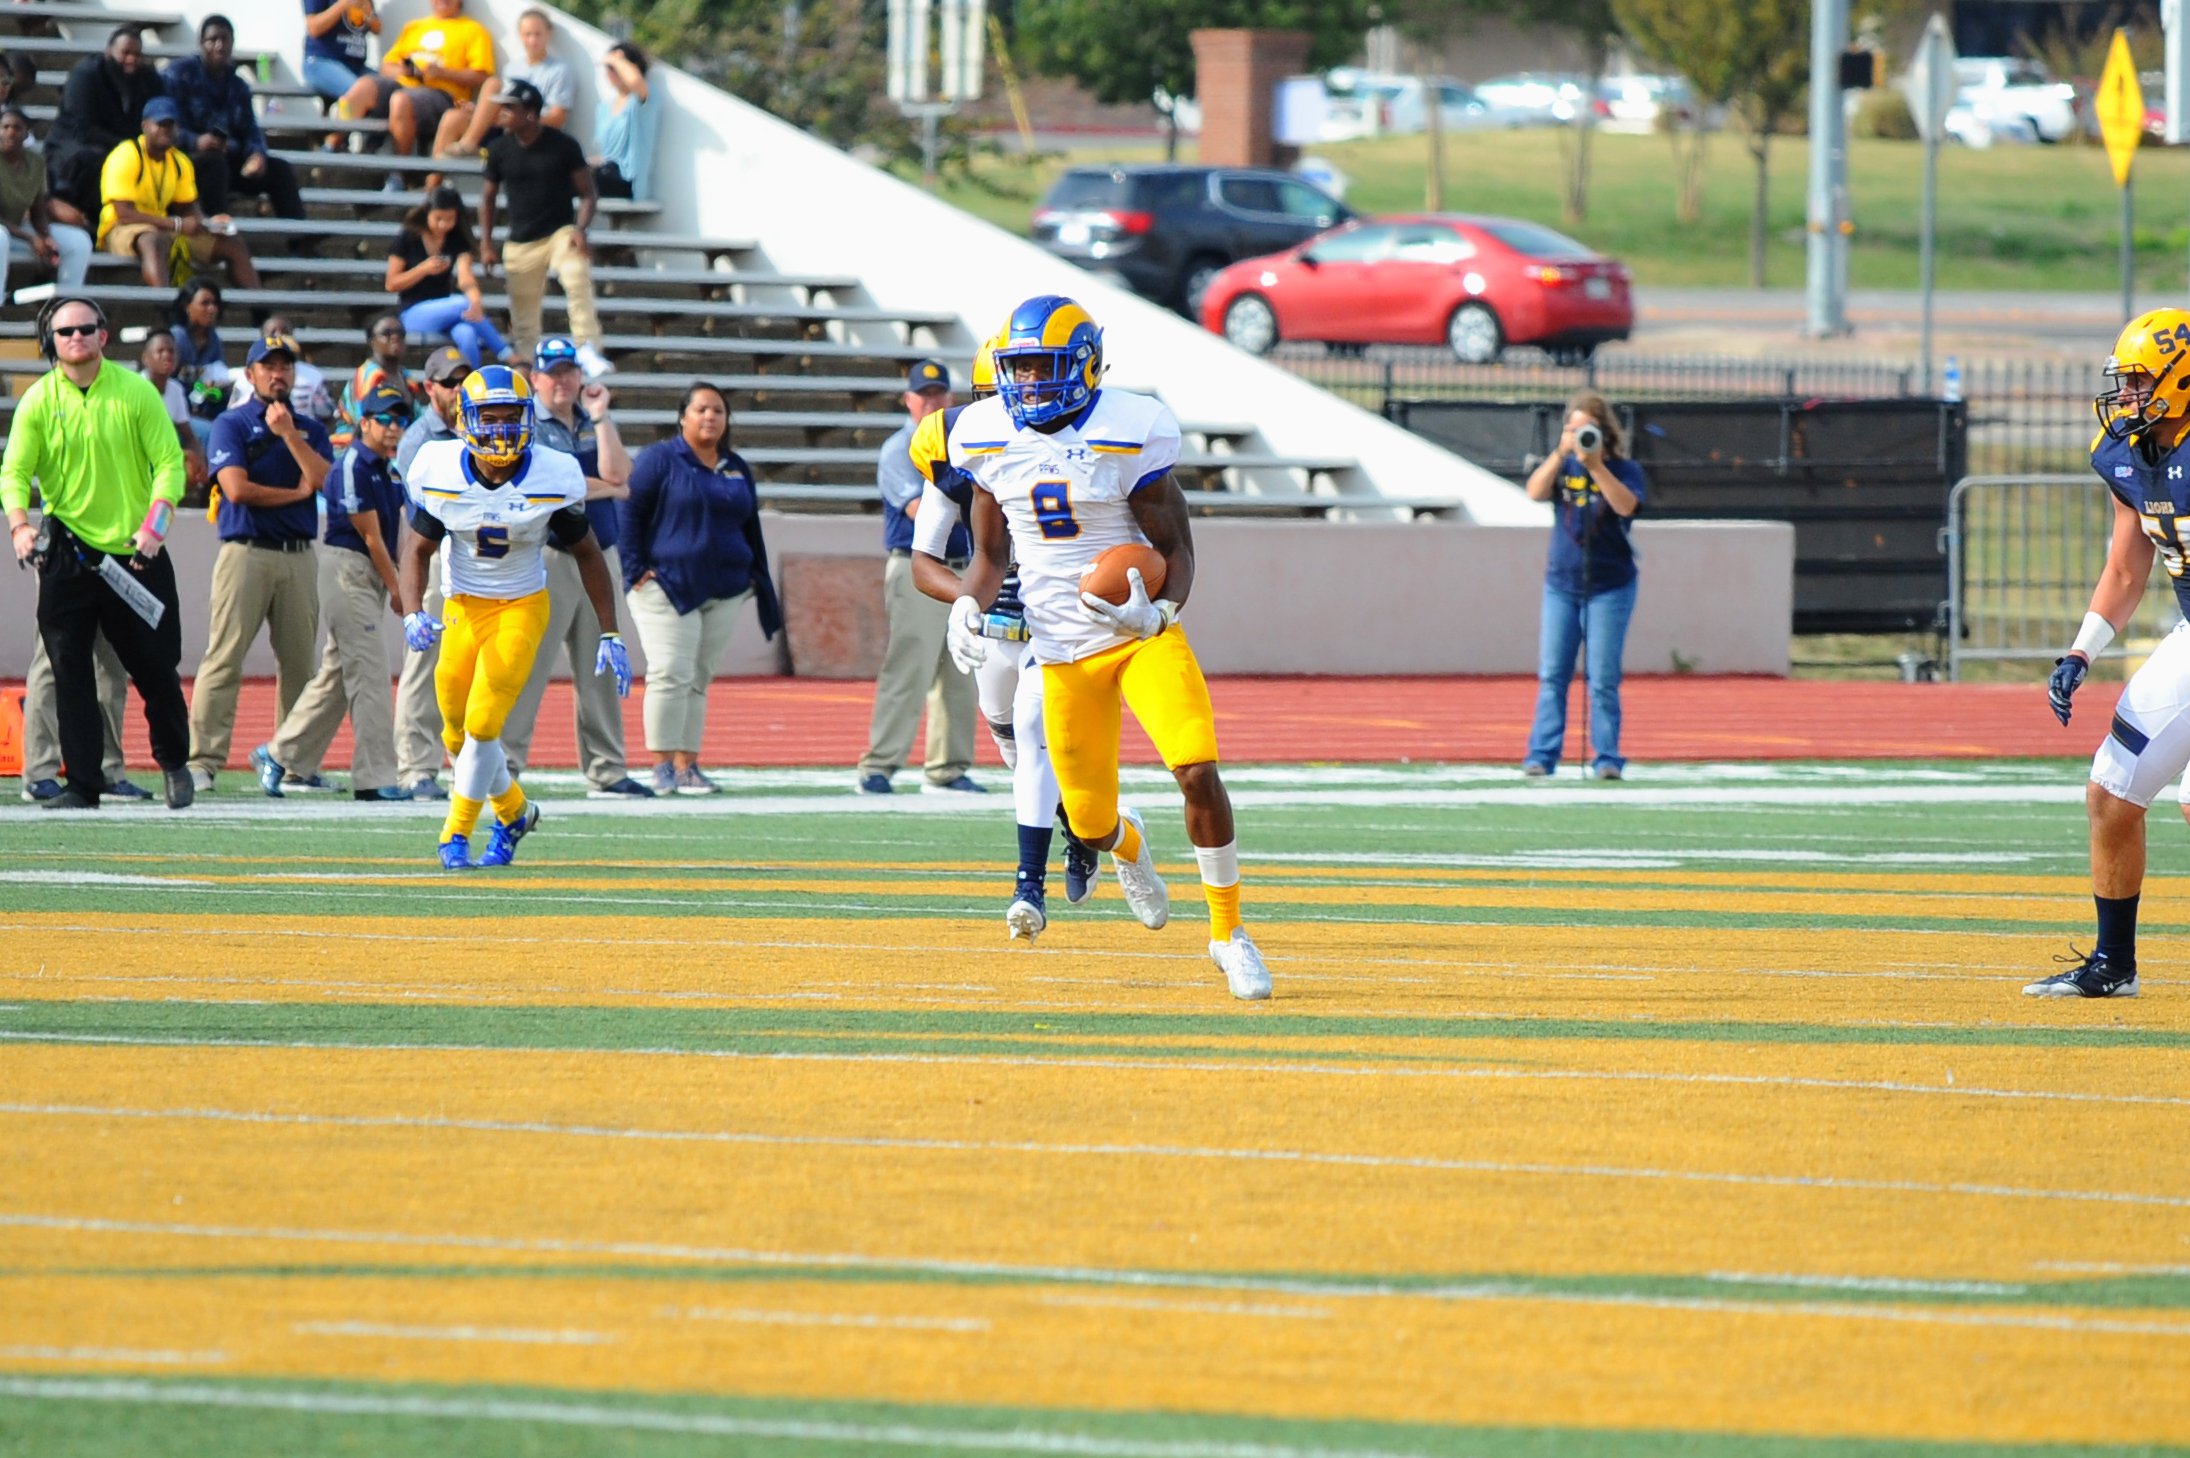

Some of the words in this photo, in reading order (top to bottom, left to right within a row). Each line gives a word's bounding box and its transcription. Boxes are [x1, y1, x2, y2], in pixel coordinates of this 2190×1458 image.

[2153, 323, 2190, 355] 54
[1029, 481, 1082, 541] 8
[2144, 500, 2175, 515] LIONS
